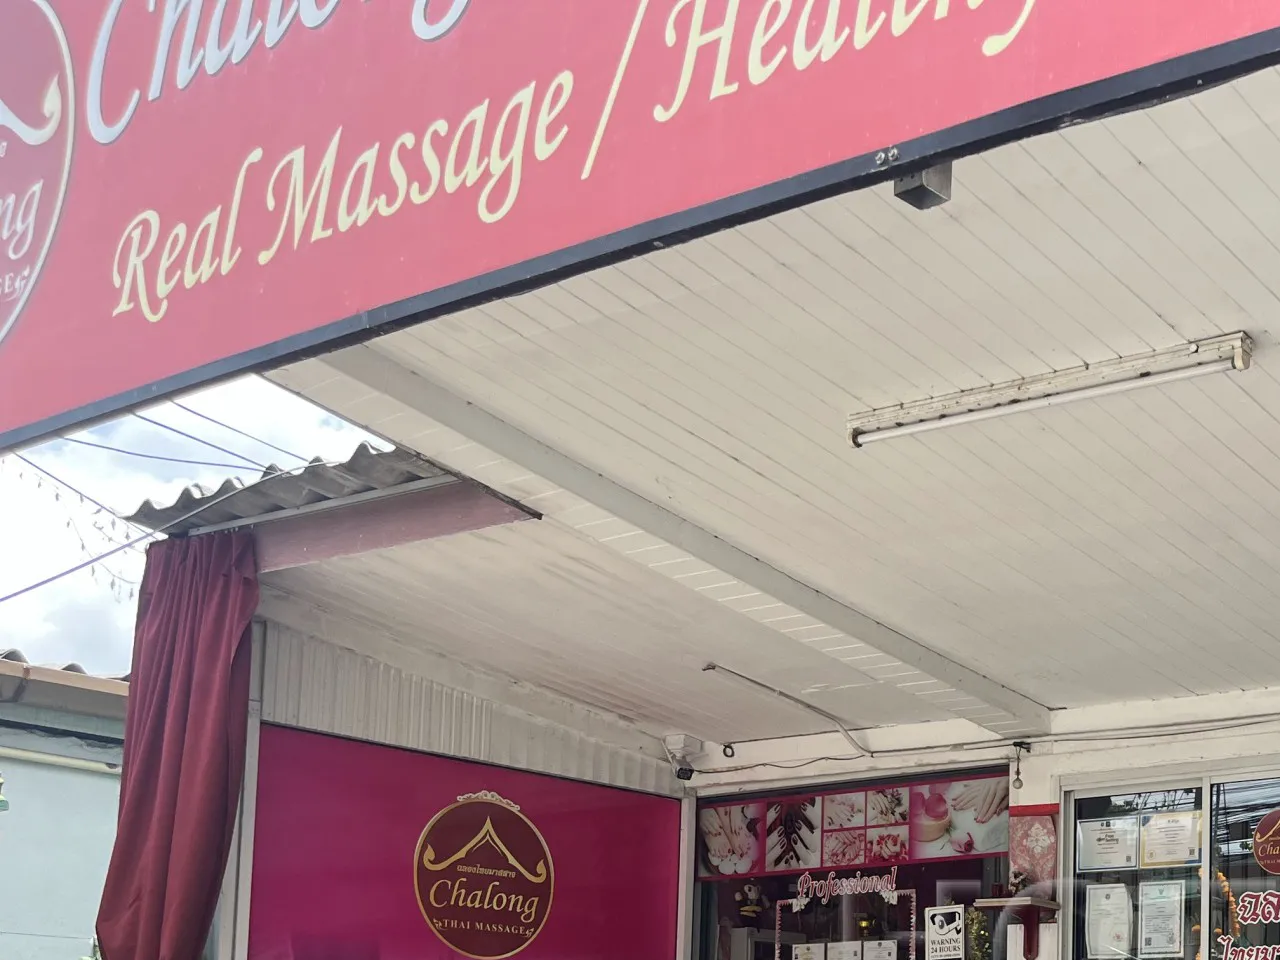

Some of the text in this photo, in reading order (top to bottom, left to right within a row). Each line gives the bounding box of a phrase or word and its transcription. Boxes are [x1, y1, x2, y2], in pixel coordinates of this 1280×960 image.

[112, 147, 263, 322] Real
[259, 69, 574, 264] Massage
[798, 866, 898, 904] Professional
[429, 878, 540, 923] Chalong
[443, 919, 526, 935] THAI MASSAGE
[931, 938, 961, 946] WARNING
[939, 945, 961, 953] HOURS
